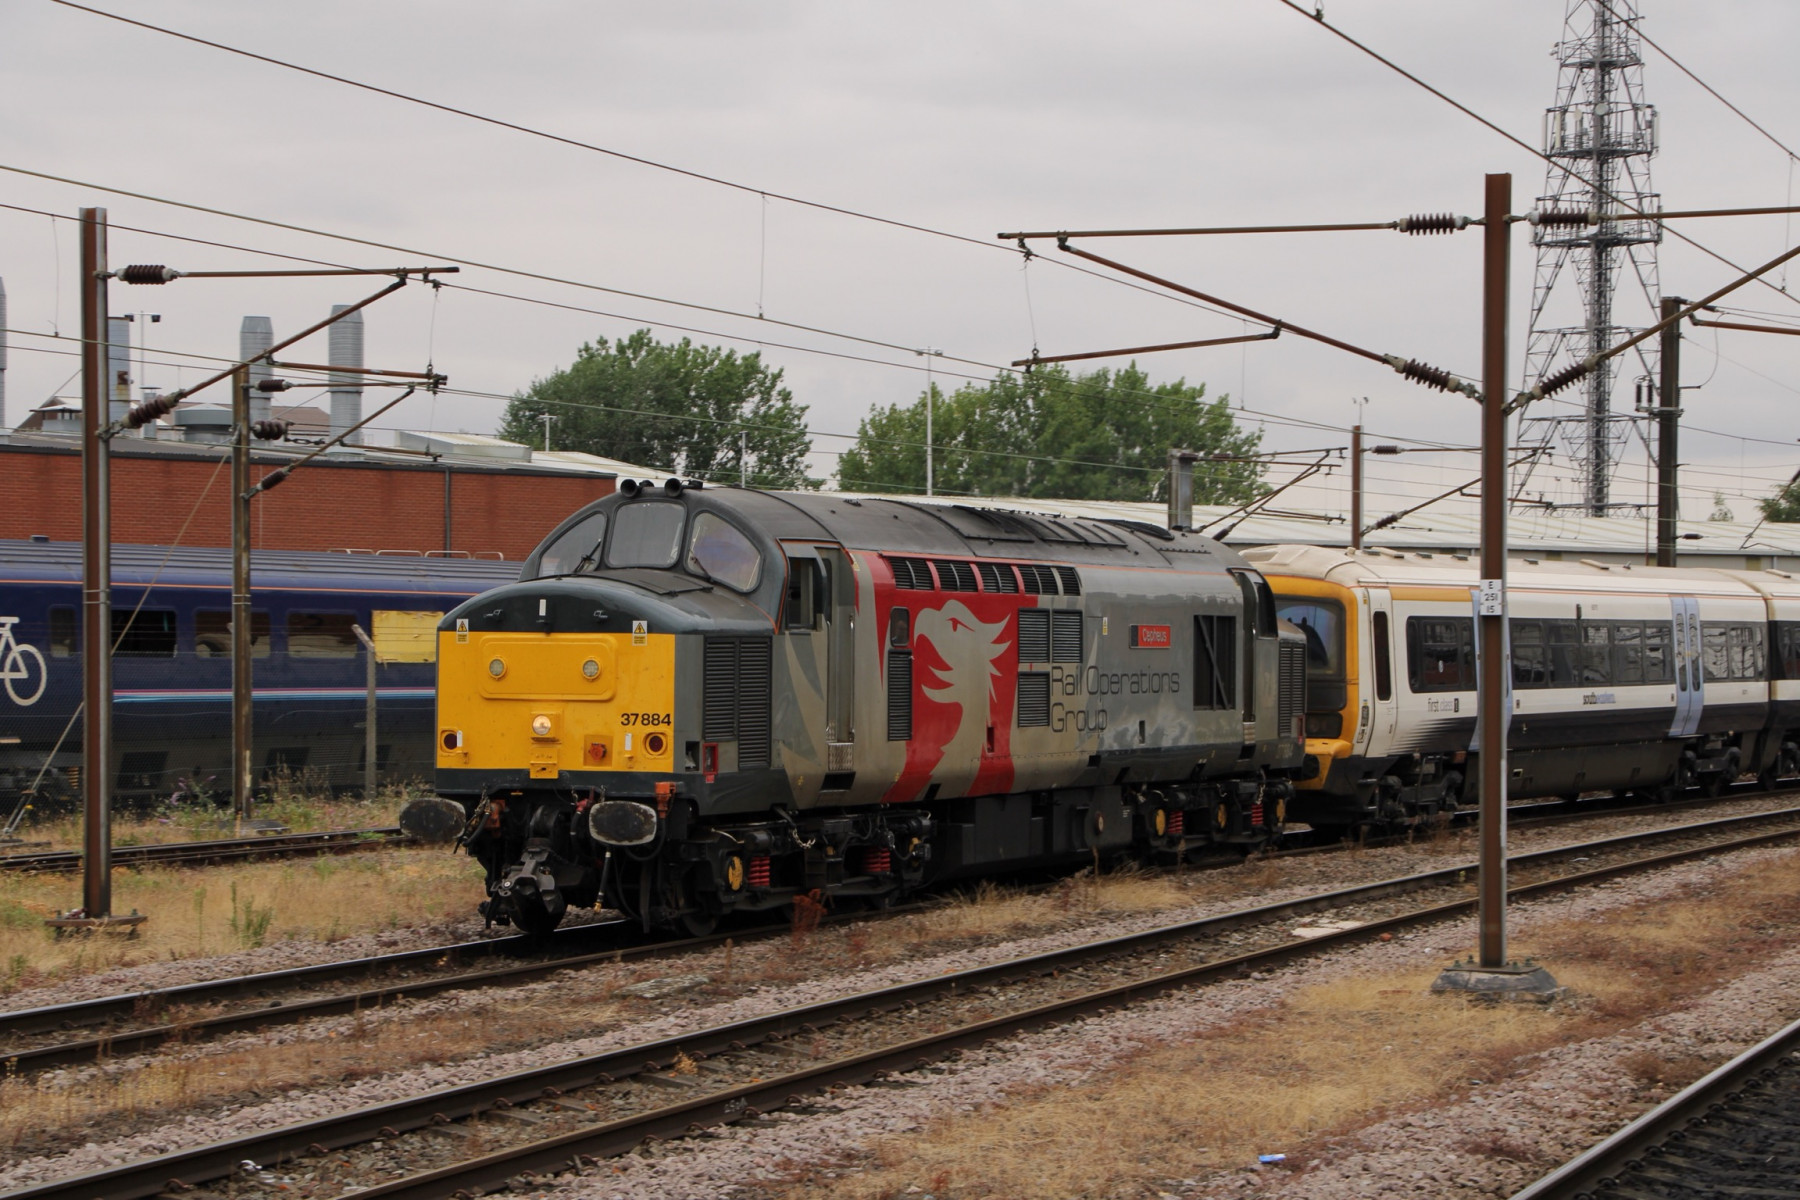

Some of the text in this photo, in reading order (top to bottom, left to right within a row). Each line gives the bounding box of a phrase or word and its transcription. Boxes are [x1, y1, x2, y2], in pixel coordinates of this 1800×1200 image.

[1488, 580, 1494, 590] E
[1484, 592, 1499, 602] 251
[1486, 605, 1495, 614] 15
[1051, 665, 1180, 702] Rail Operations
[1427, 697, 1439, 712] first
[620, 712, 672, 727] 37884
[1051, 702, 1108, 738] Group
